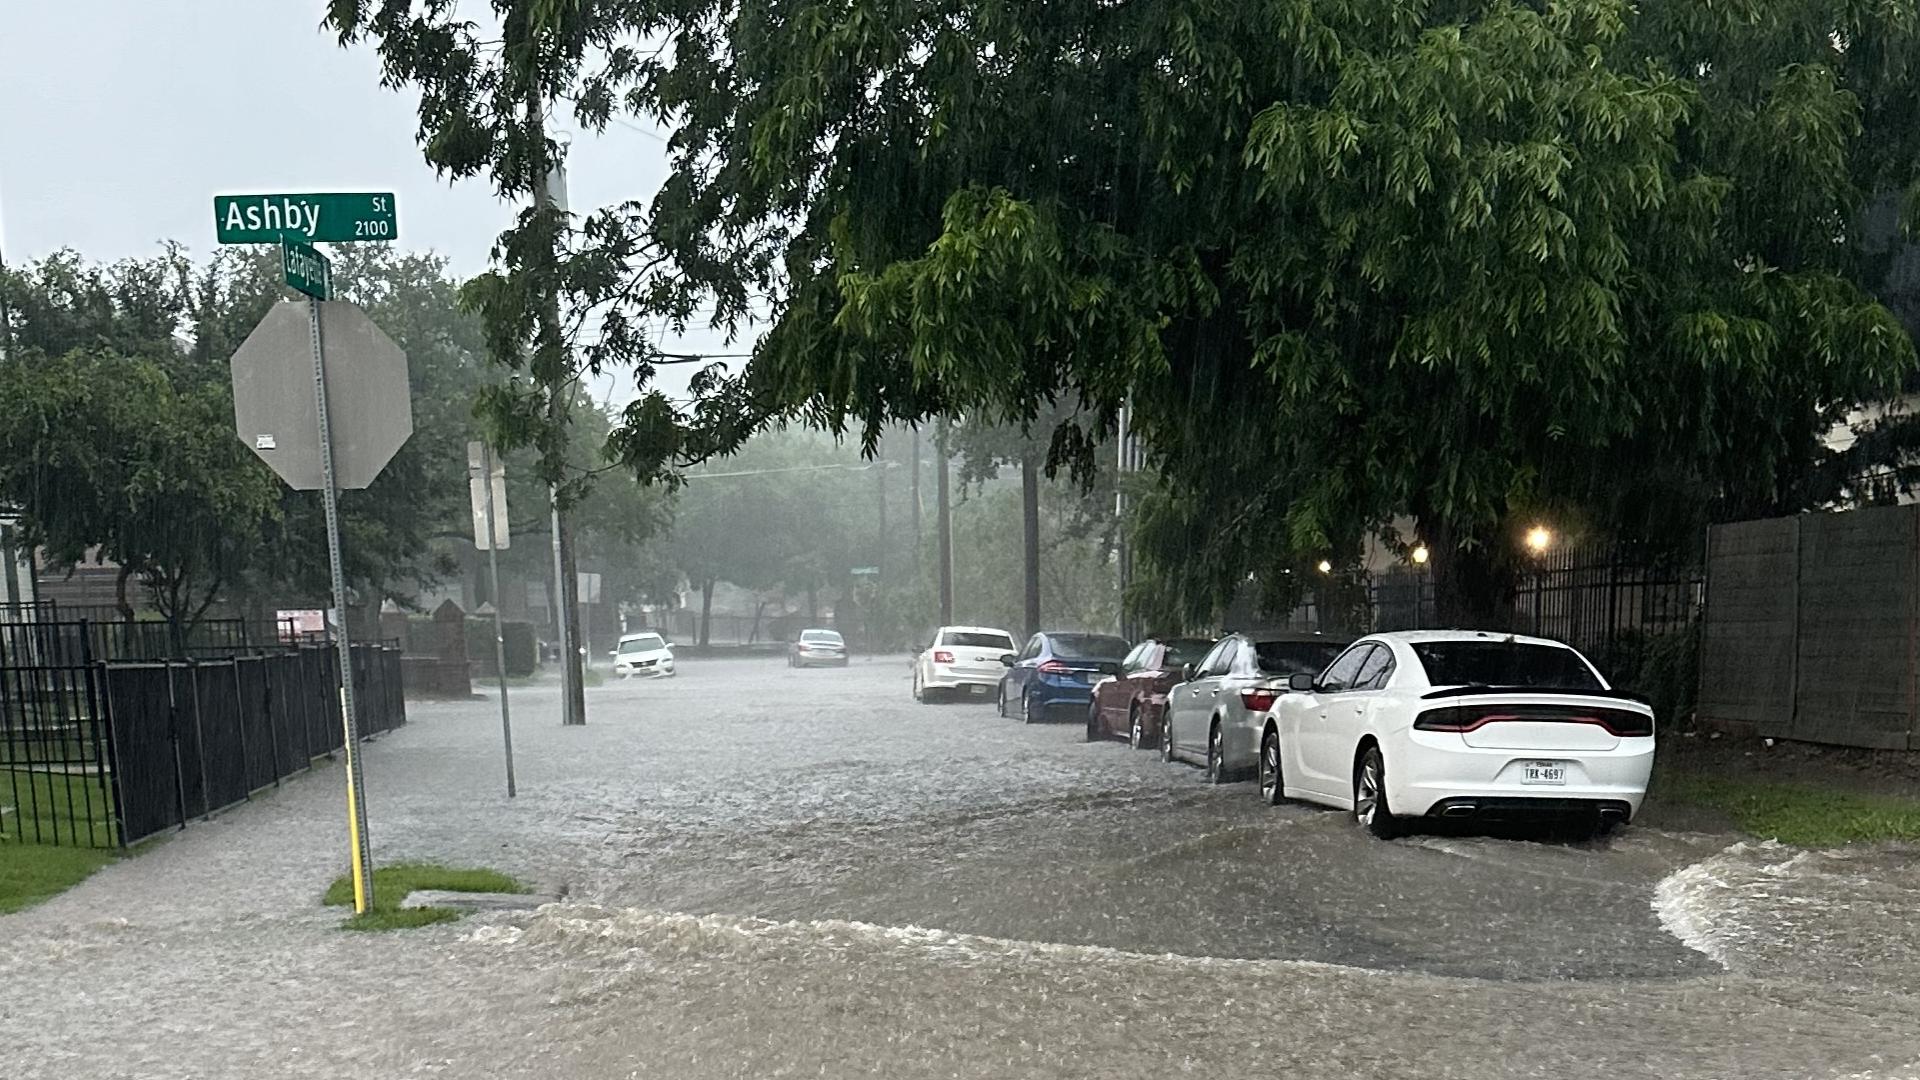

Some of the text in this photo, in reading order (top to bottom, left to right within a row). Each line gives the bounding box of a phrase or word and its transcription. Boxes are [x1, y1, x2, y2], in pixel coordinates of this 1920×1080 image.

[225, 197, 387, 237] Ashby St
[355, 220, 388, 236] 2100
[285, 244, 322, 287] Lafaye
